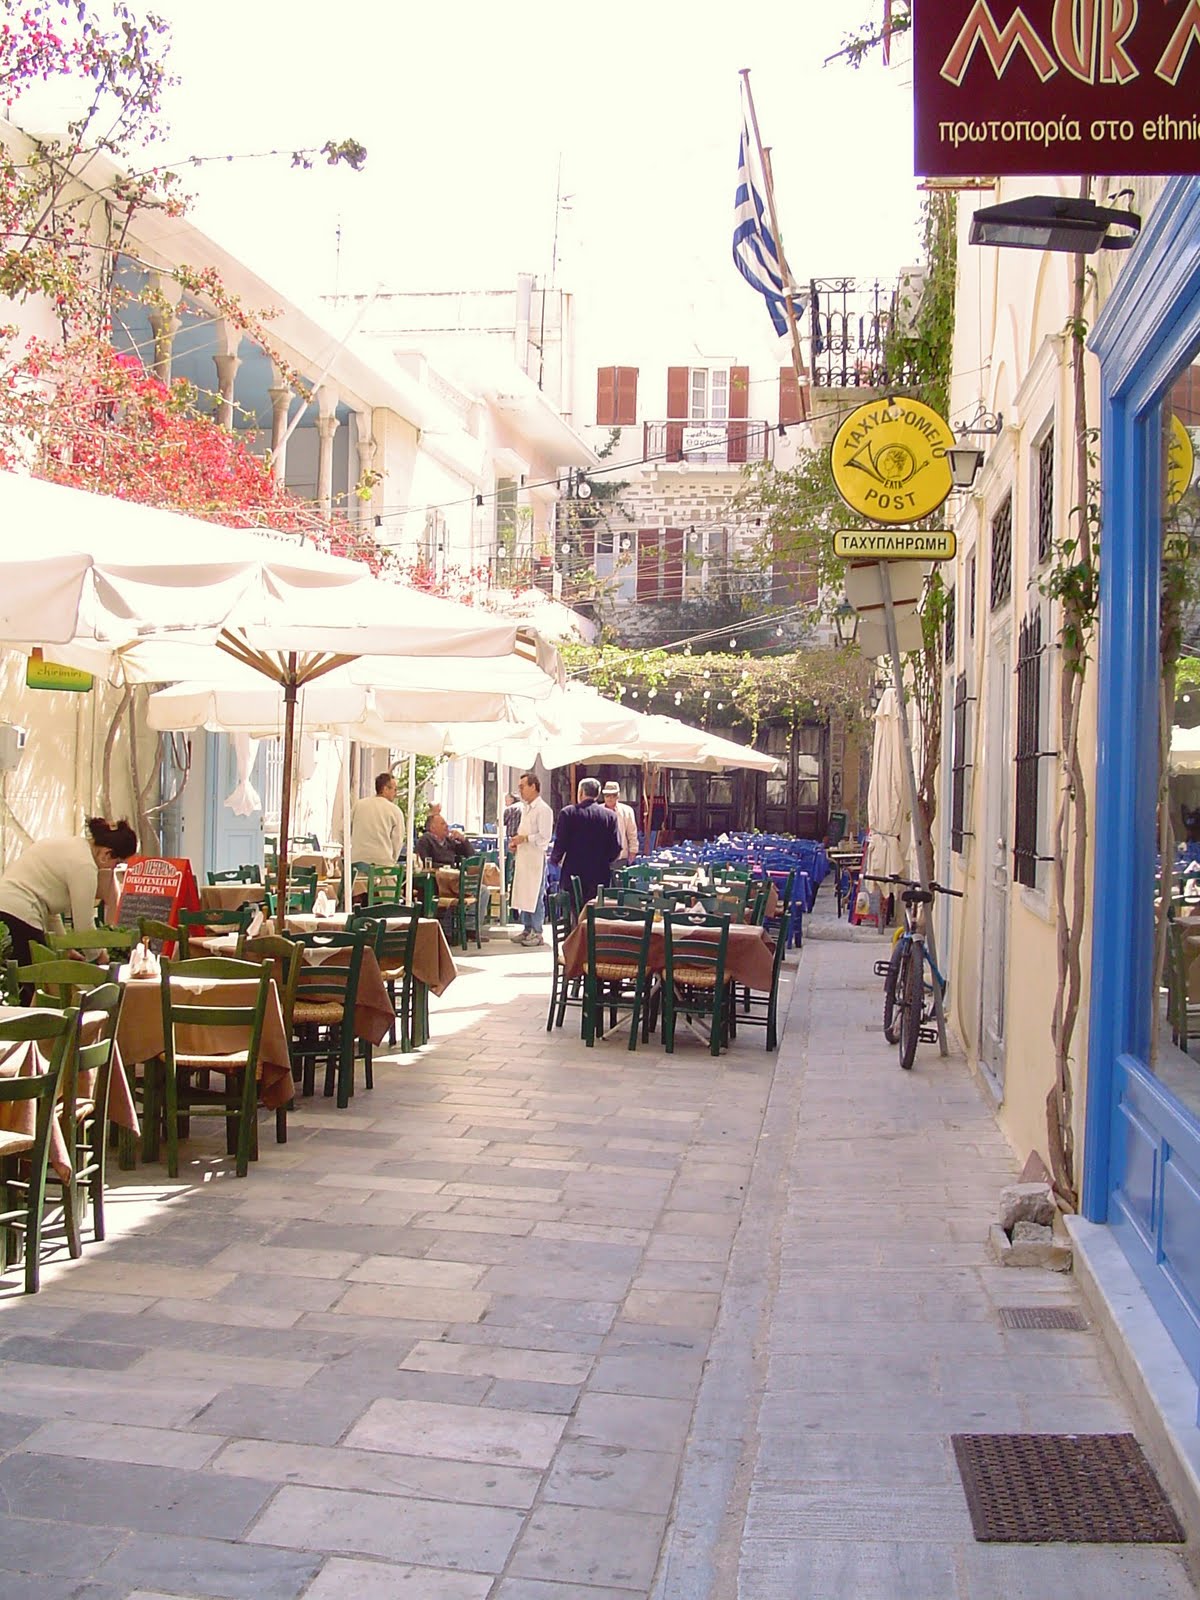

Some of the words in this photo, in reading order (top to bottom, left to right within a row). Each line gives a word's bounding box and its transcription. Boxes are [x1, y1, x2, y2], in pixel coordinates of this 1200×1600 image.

[938, 114, 1082, 148] πρωτοπορία
[1090, 120, 1134, 141] στο
[865, 489, 915, 510] POST
[841, 536, 948, 550] ΤΑΧΥΠΛΗΡΩΜΗ
[127, 877, 178, 886] ΟΙΚΟΓΕΝΕΙΑΚΗ
[135, 885, 165, 894] ΤΑΒΕΡΝΑ
